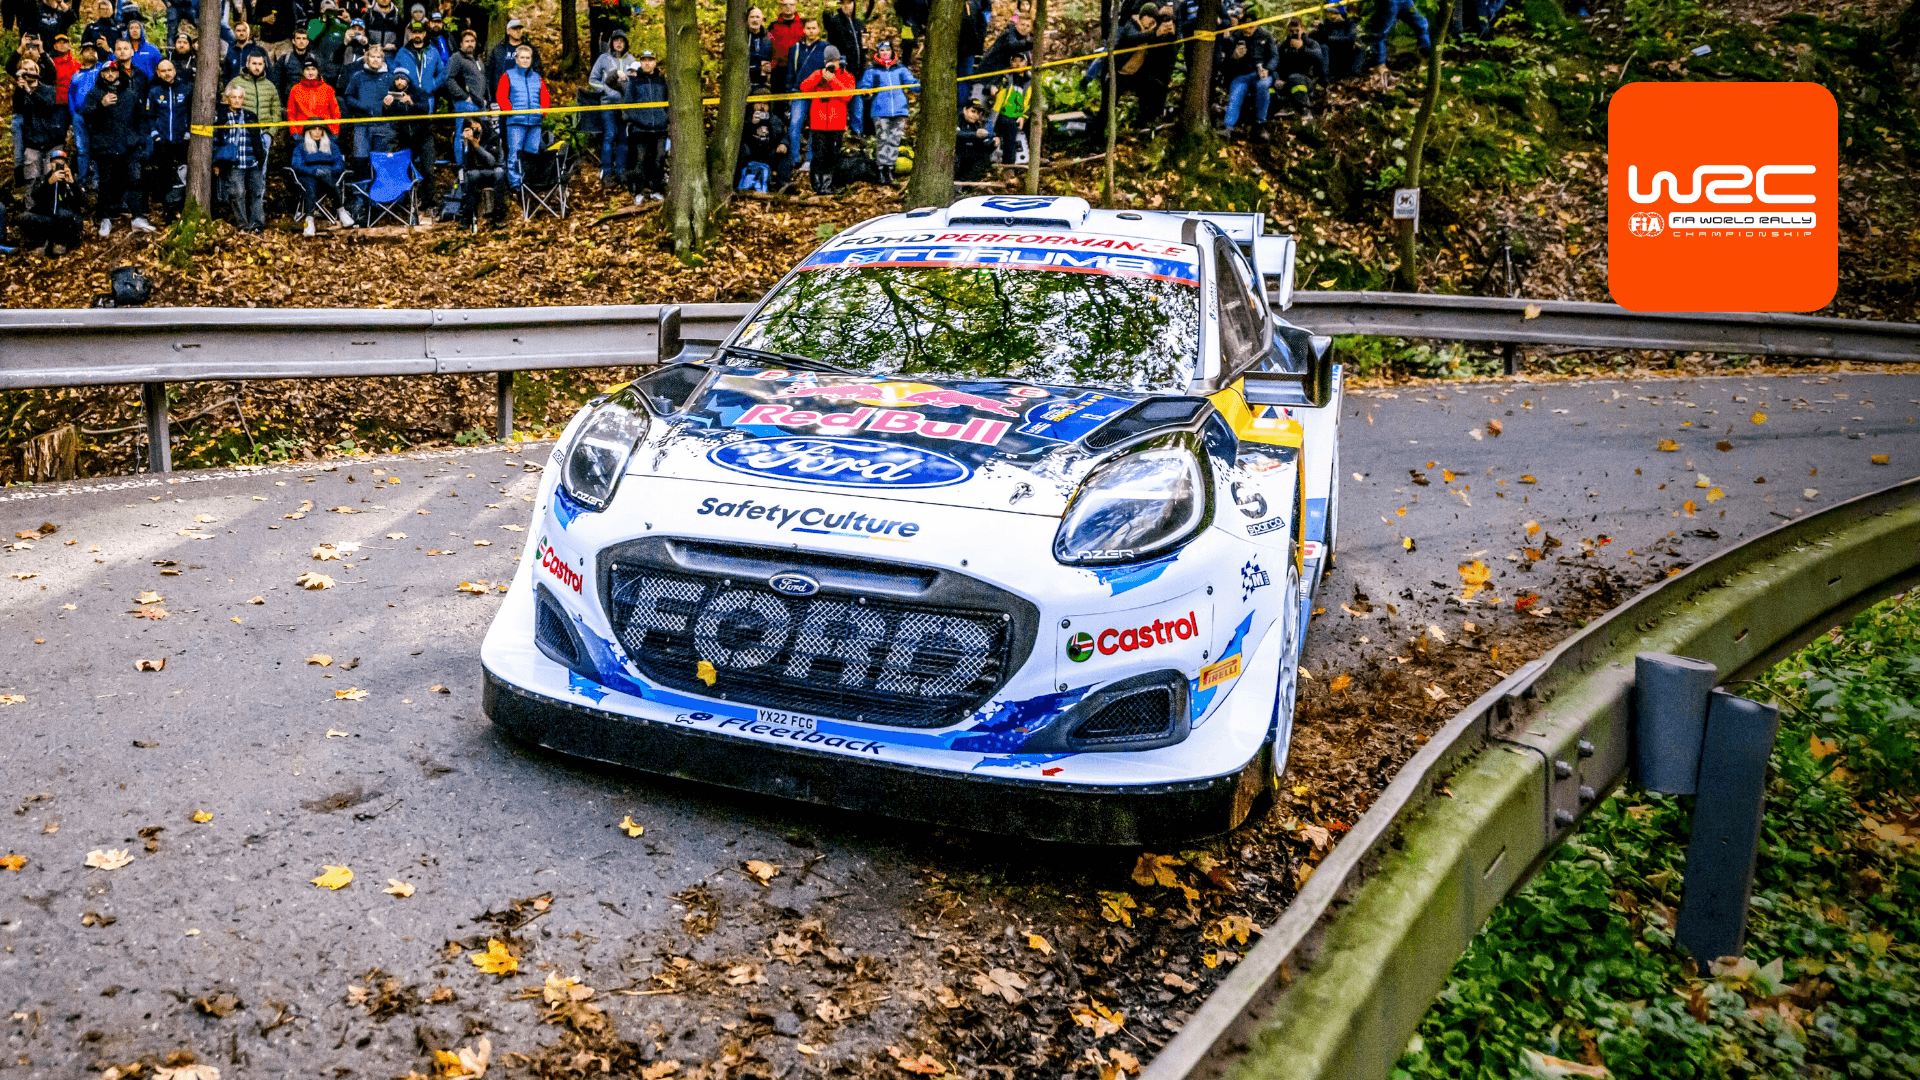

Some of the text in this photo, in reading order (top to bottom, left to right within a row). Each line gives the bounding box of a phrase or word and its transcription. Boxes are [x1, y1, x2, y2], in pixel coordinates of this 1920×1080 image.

[835, 234, 936, 248] FORD
[886, 248, 1155, 274] FORUM8
[735, 405, 876, 429] Red
[870, 410, 1011, 446] Bull
[748, 439, 922, 481] Ford
[697, 497, 920, 538] SafetyCulture
[1247, 517, 1283, 536] sparco
[542, 546, 584, 595] Castrol
[778, 578, 808, 592] Ford
[623, 575, 990, 697] FORD
[1097, 610, 1199, 655] Castrol
[1203, 659, 1238, 685] PIRELLI
[718, 717, 886, 755] Fleetback
[759, 709, 814, 730] YX22 FCG
